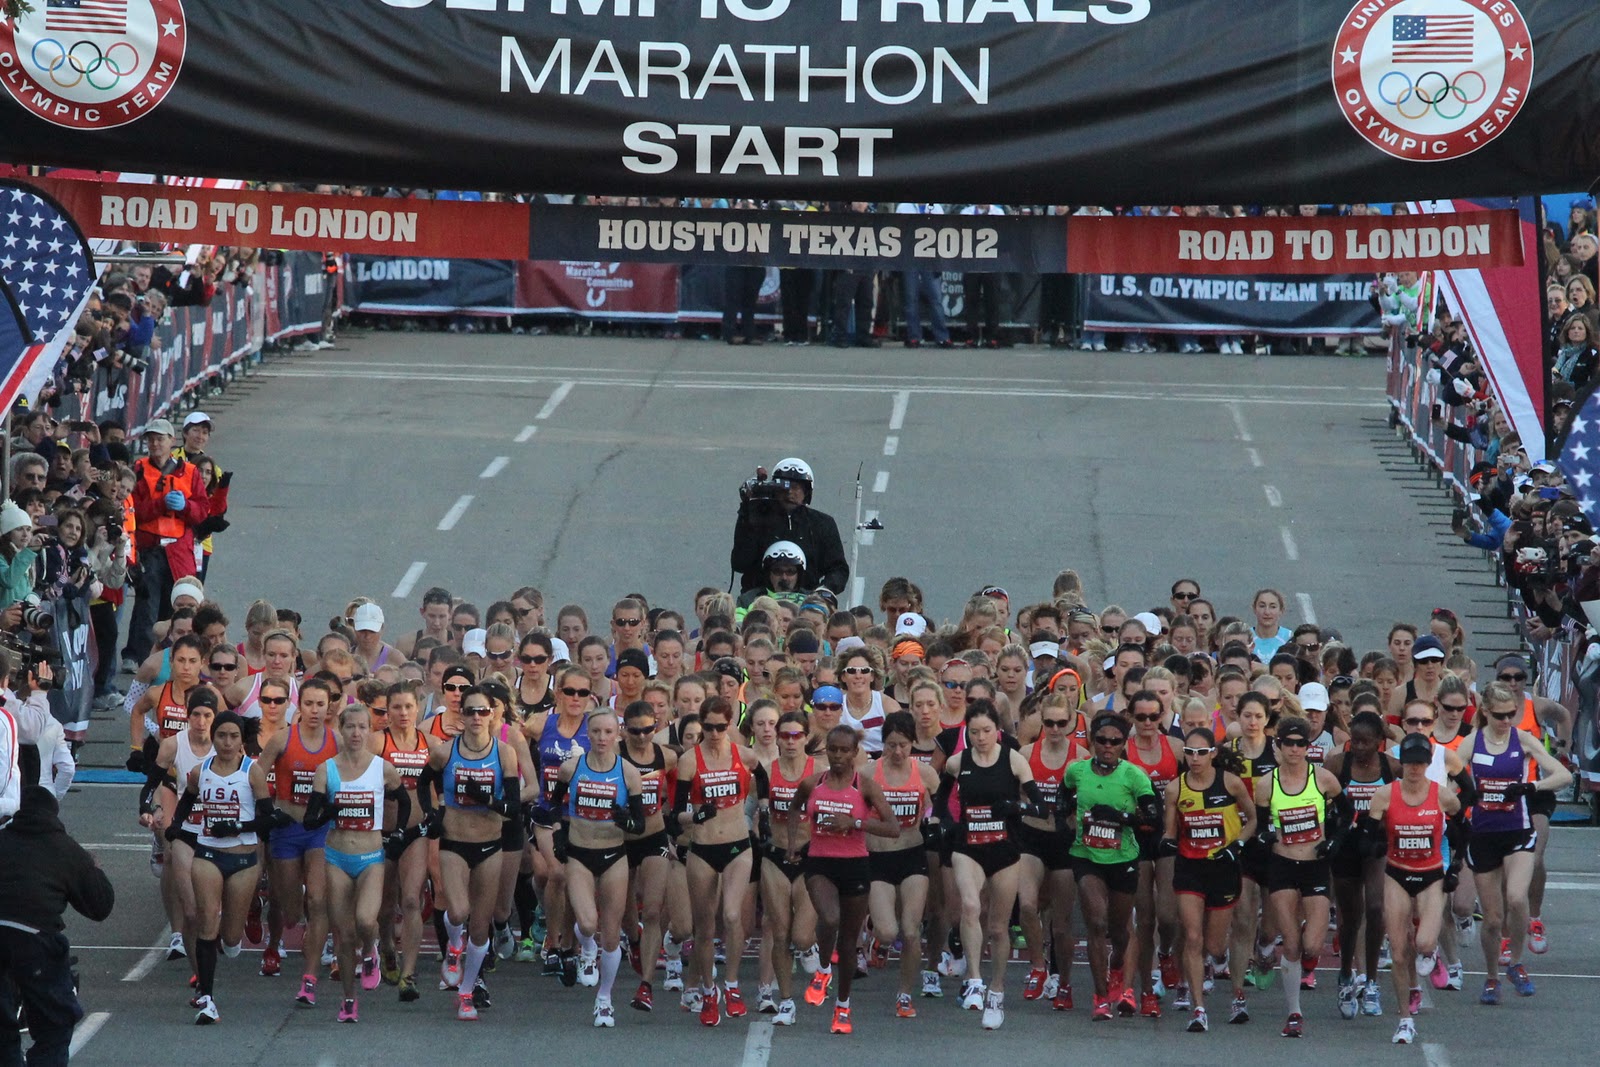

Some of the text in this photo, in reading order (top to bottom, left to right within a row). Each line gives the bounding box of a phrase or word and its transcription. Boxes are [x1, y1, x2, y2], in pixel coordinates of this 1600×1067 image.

[501, 36, 989, 104] MARATHON
[0, 52, 173, 122] OLYMPIC TEAM
[1345, 86, 1520, 155] OLYMPIC TEAM
[622, 121, 893, 177] START
[100, 195, 418, 243] ROAD TO LONDON
[598, 219, 998, 258] HOUSTON TEXAS 2012
[1178, 224, 1490, 261] ROAD TO LONDON
[357, 260, 450, 282] LONDON
[1100, 275, 1373, 302] U.S. OLYMPIC TEAM TRIA
[395, 767, 424, 777] ESTOVE
[203, 788, 240, 802] USA
[705, 783, 737, 798] STEPH
[1483, 792, 1506, 803] BECQ
[578, 796, 613, 809] SHALANE
[891, 804, 916, 815] MITH
[968, 821, 1004, 832] BAUMERT
[1088, 825, 1116, 839] AKOR
[1191, 827, 1219, 838] DAVILA
[1284, 820, 1316, 833] HASTINGS
[1399, 837, 1431, 849] DEENA
